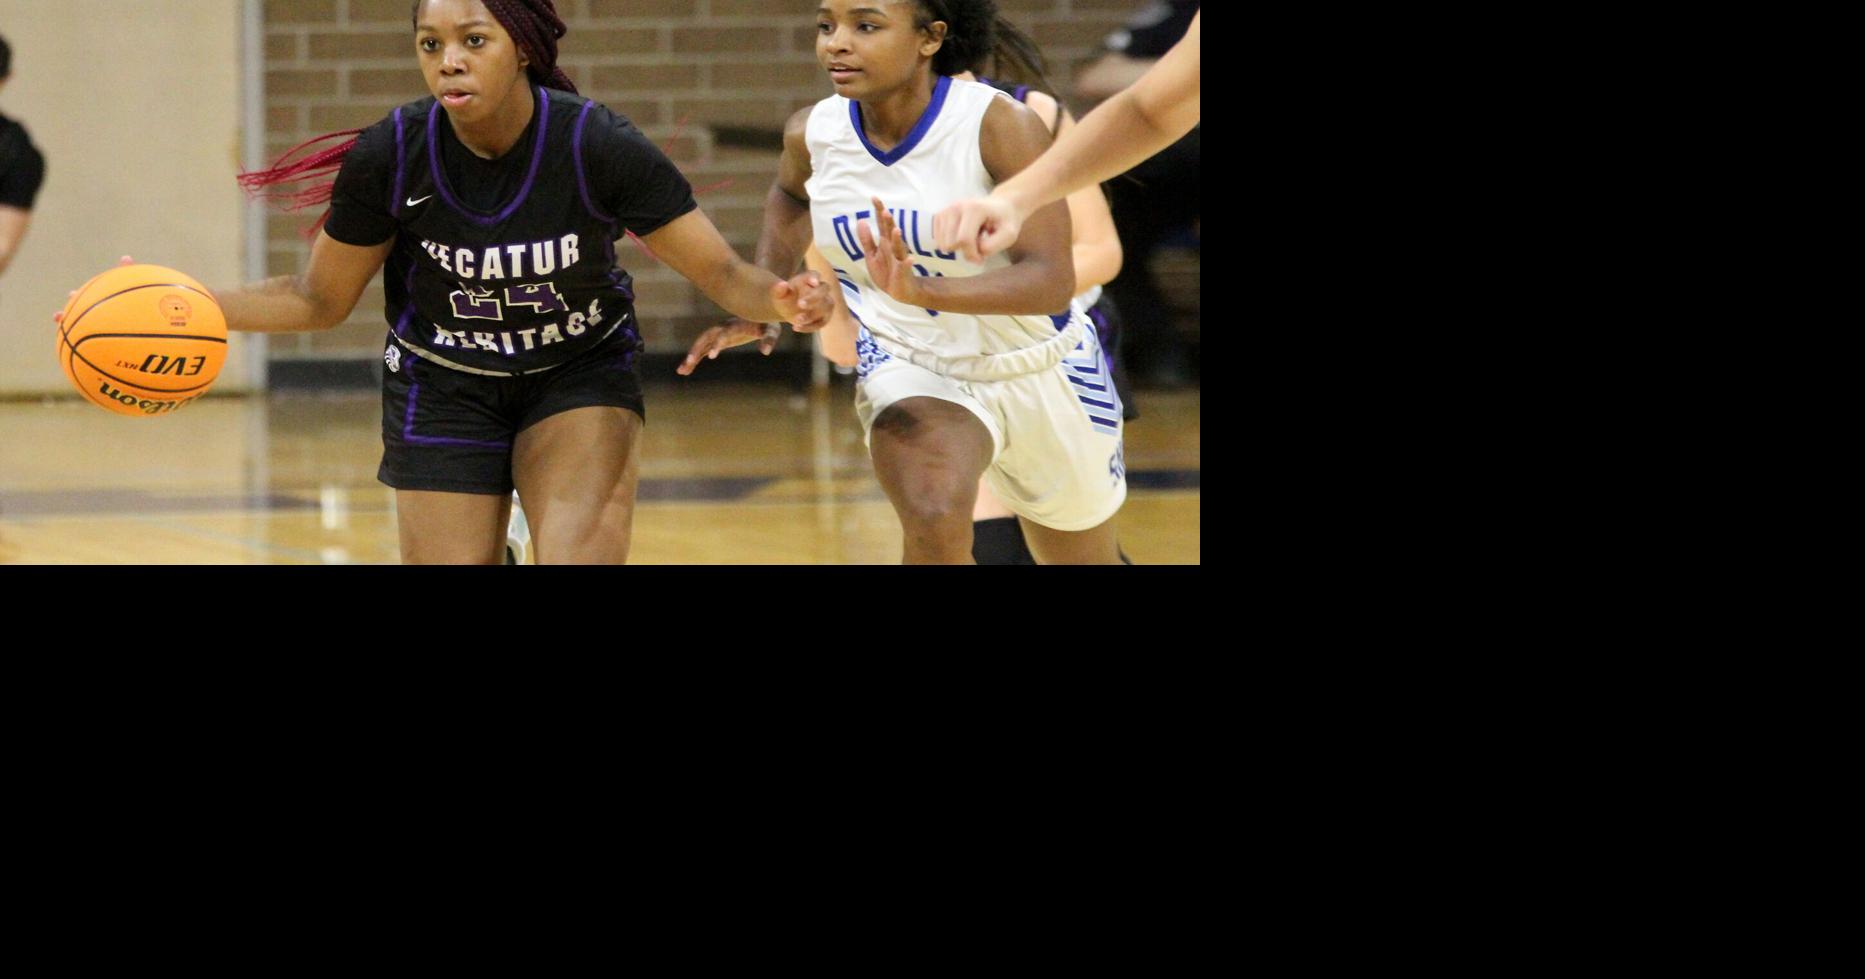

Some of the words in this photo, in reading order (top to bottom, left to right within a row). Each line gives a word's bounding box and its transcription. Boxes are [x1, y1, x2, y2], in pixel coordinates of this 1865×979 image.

[832, 208, 957, 262] DIL
[449, 282, 570, 321] 24
[139, 354, 206, 376] EVO
